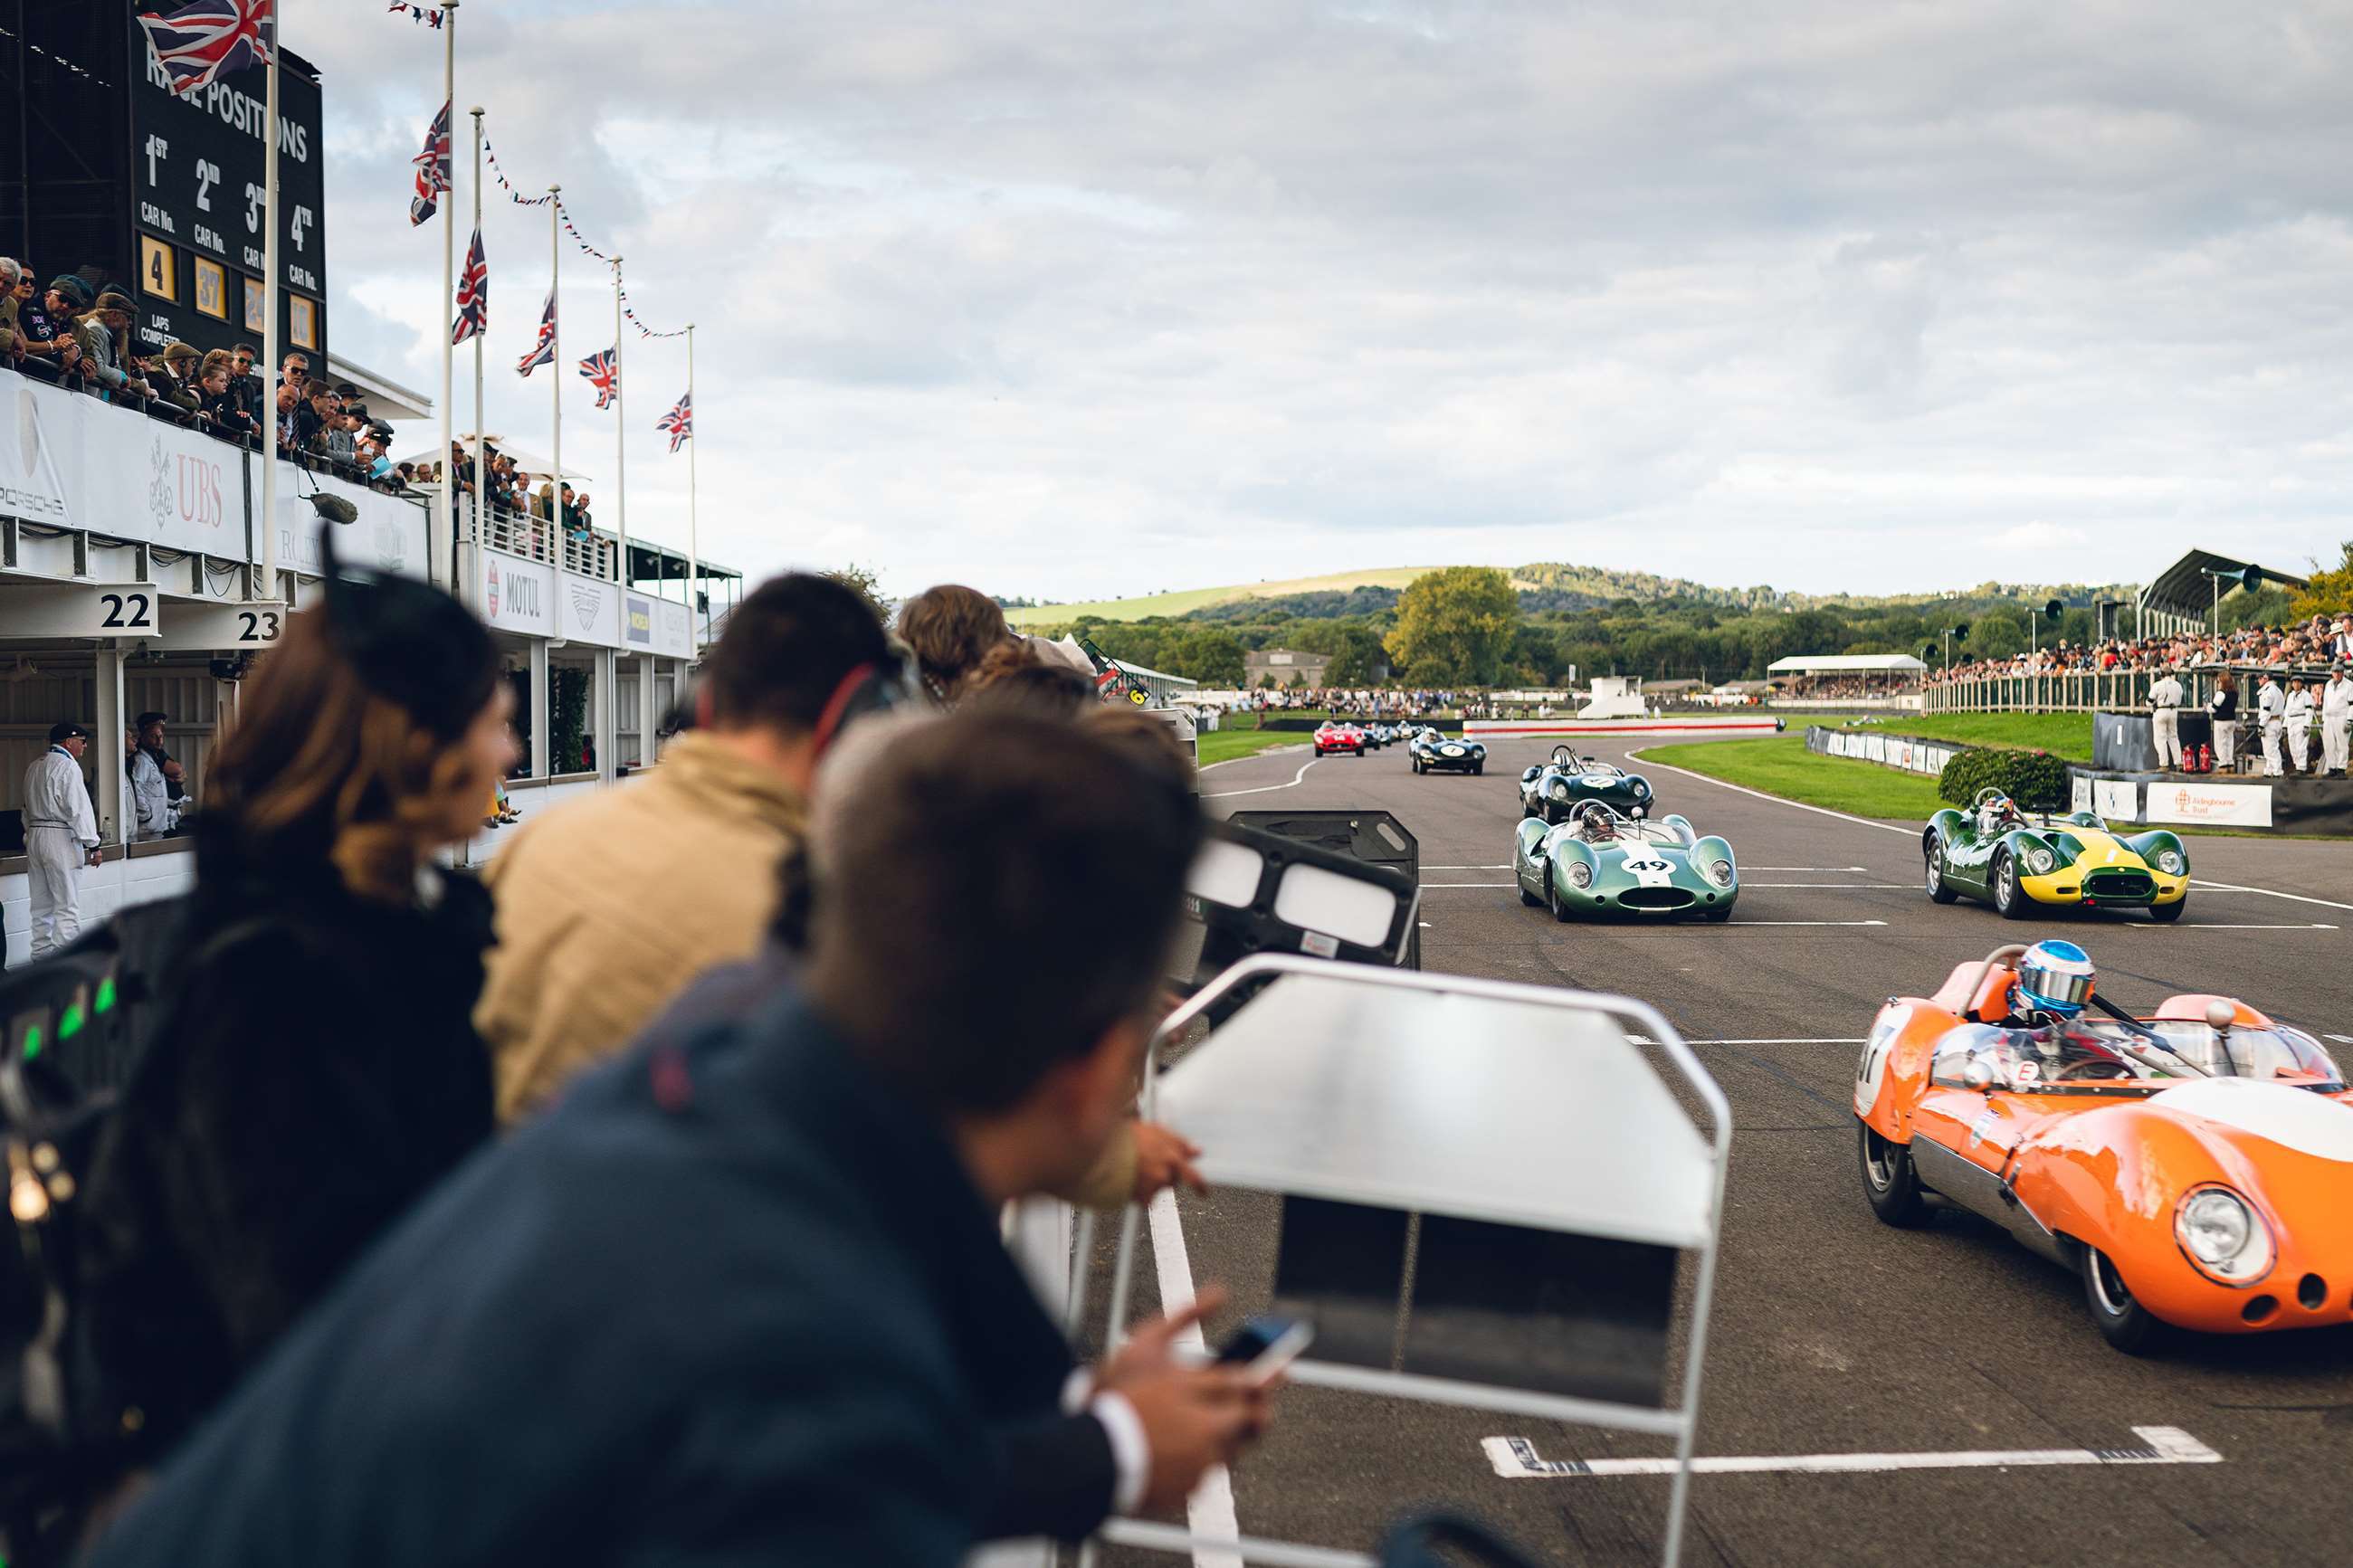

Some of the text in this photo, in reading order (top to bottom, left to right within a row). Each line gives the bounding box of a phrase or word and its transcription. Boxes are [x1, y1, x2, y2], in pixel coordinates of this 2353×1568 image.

[146, 134, 167, 186] 1ST
[195, 158, 220, 212] 2ND
[141, 201, 159, 226] CAR
[291, 204, 312, 252] 4TH
[195, 224, 211, 248] CAR
[151, 250, 163, 290] 4
[243, 245, 260, 269] CAR
[199, 266, 220, 310] 37
[289, 264, 304, 287] CAR
[151, 313, 169, 331] LAPS
[176, 453, 222, 528] UBS
[506, 572, 540, 617] MOTUL
[100, 594, 150, 628] 22
[238, 612, 280, 641] 23
[1629, 860, 1669, 871] 49
[2017, 1063, 2034, 1082] E
